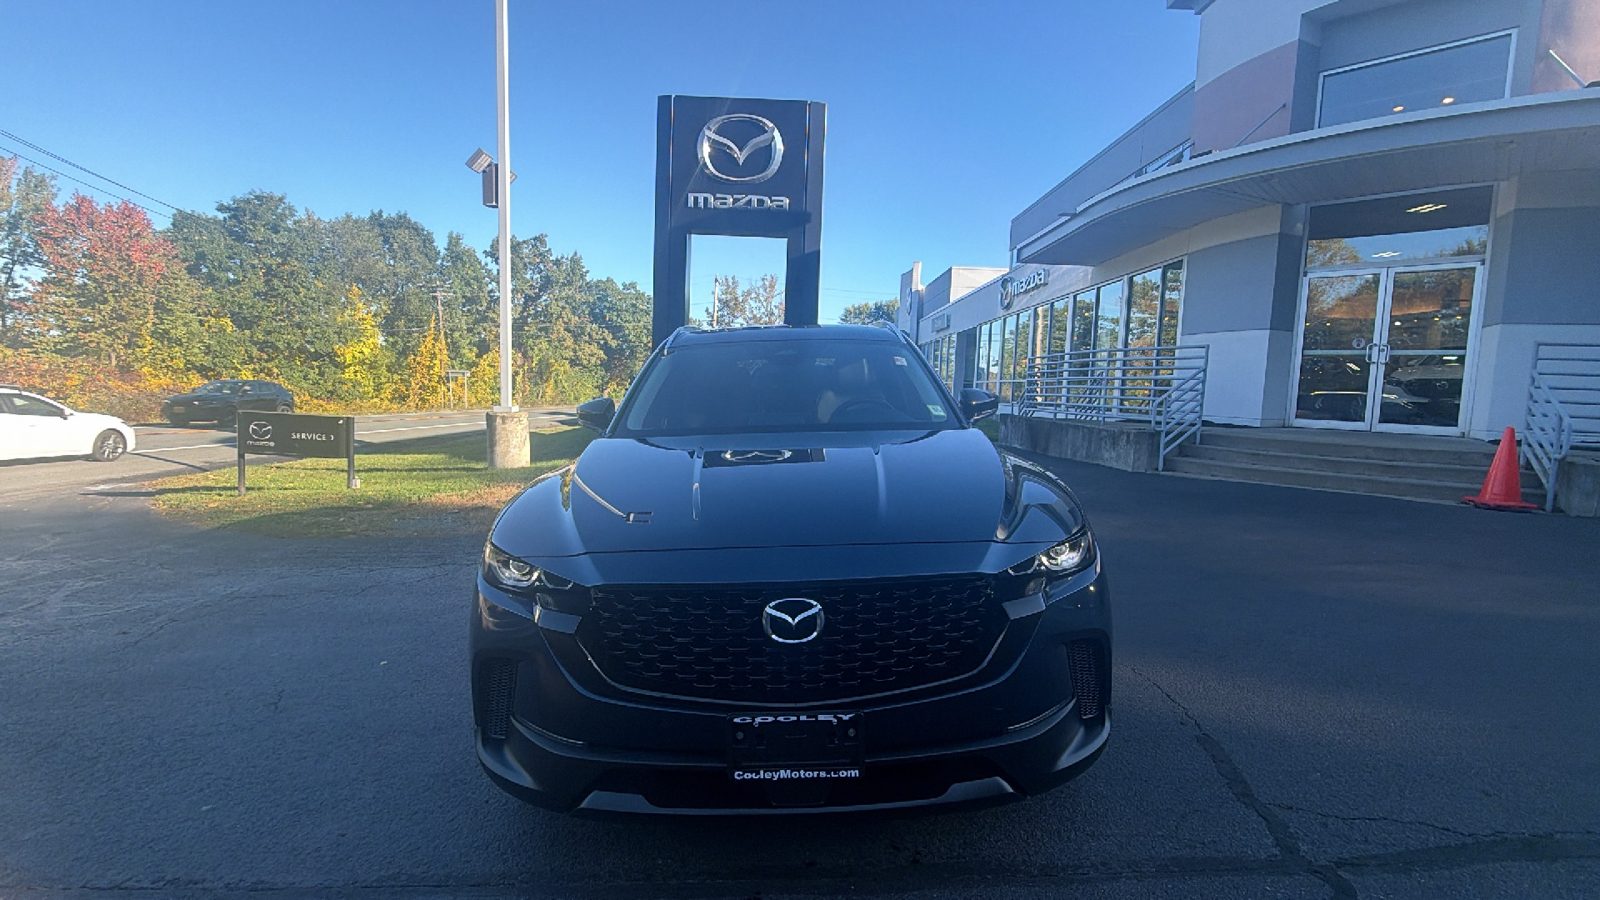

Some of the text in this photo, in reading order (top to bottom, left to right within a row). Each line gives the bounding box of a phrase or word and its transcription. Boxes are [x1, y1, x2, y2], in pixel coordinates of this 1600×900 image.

[291, 432, 327, 441] SERVICE
[733, 714, 856, 723] COOLEY
[734, 769, 860, 781] CooleyMotors.com
